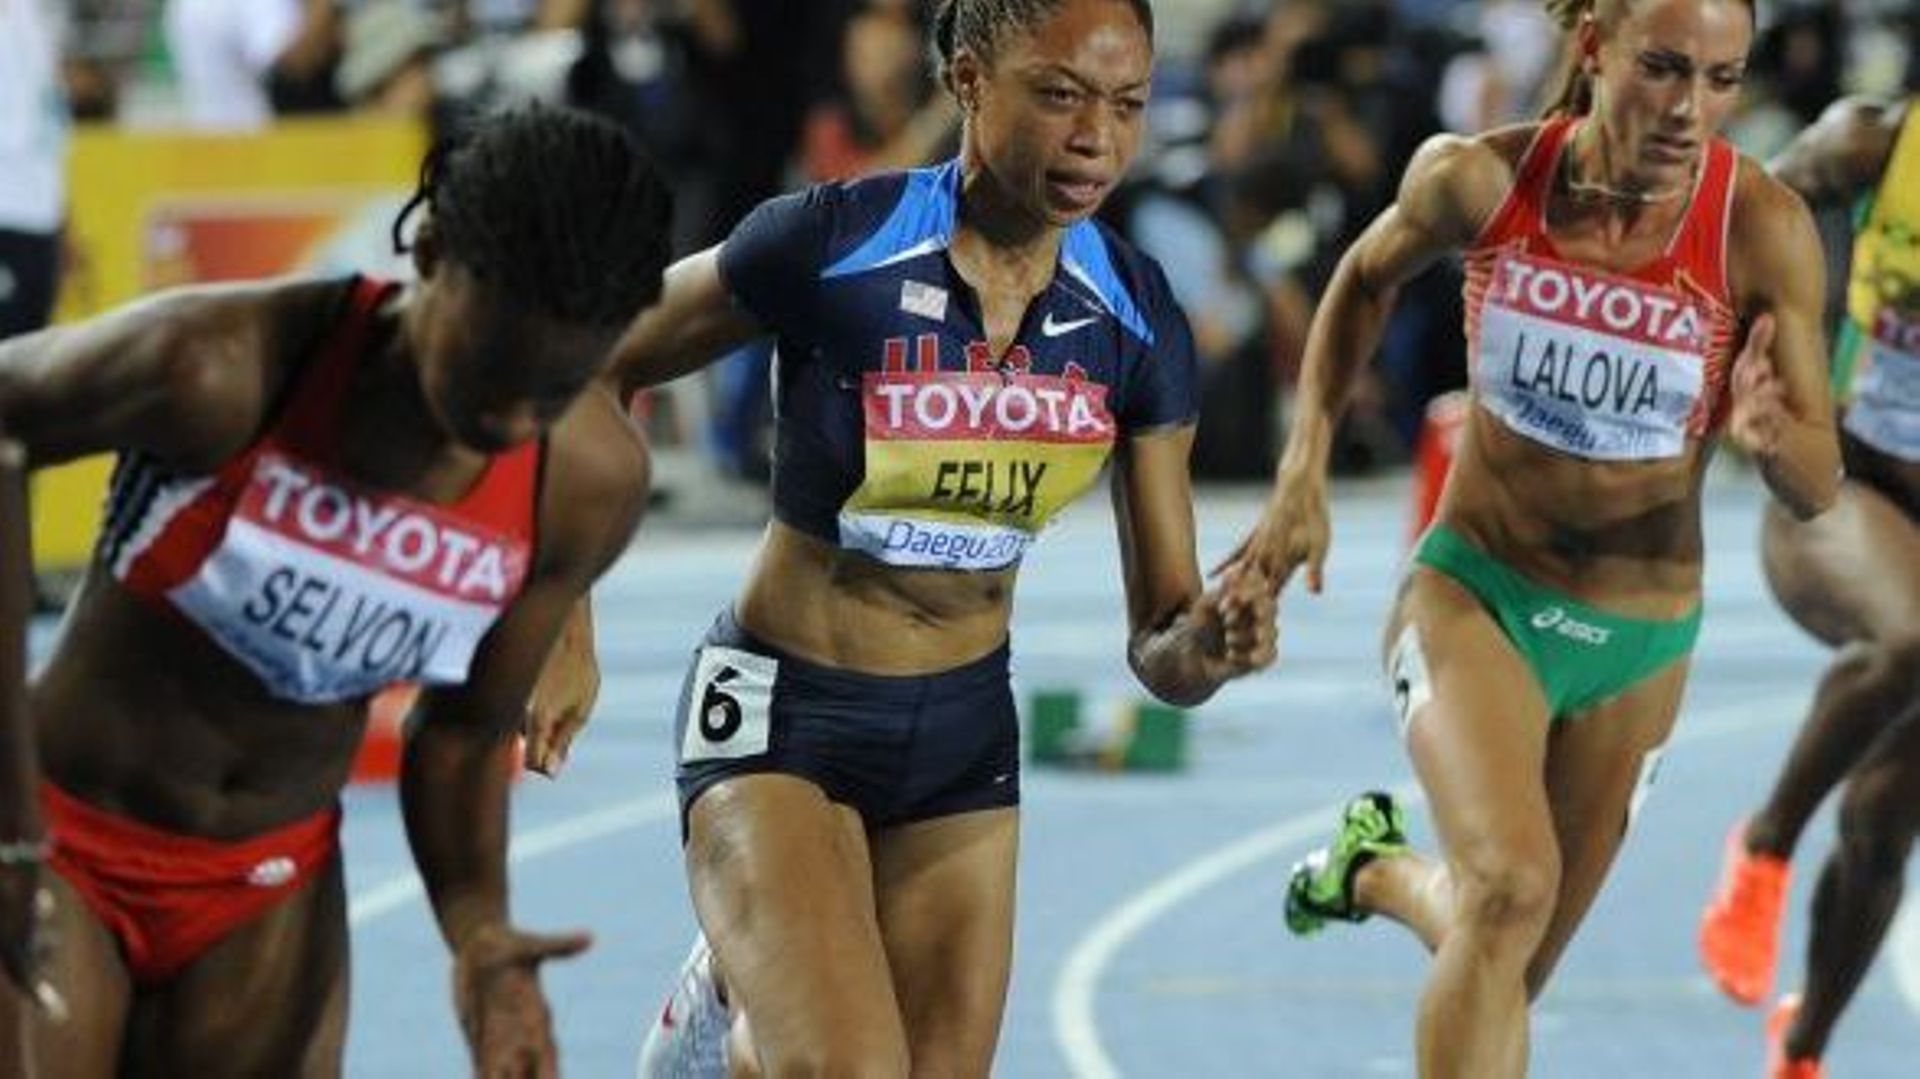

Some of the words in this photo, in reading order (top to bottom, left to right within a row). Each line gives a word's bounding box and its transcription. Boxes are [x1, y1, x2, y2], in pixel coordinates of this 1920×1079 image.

[1504, 260, 1701, 344] TOYOTA
[876, 383, 1106, 433] TOYOTA
[1511, 331, 1659, 415] LALOVA
[255, 455, 507, 598] TOYOTA
[931, 461, 1047, 516] FELIX
[242, 566, 448, 677] SELVON
[699, 665, 742, 742] 6
